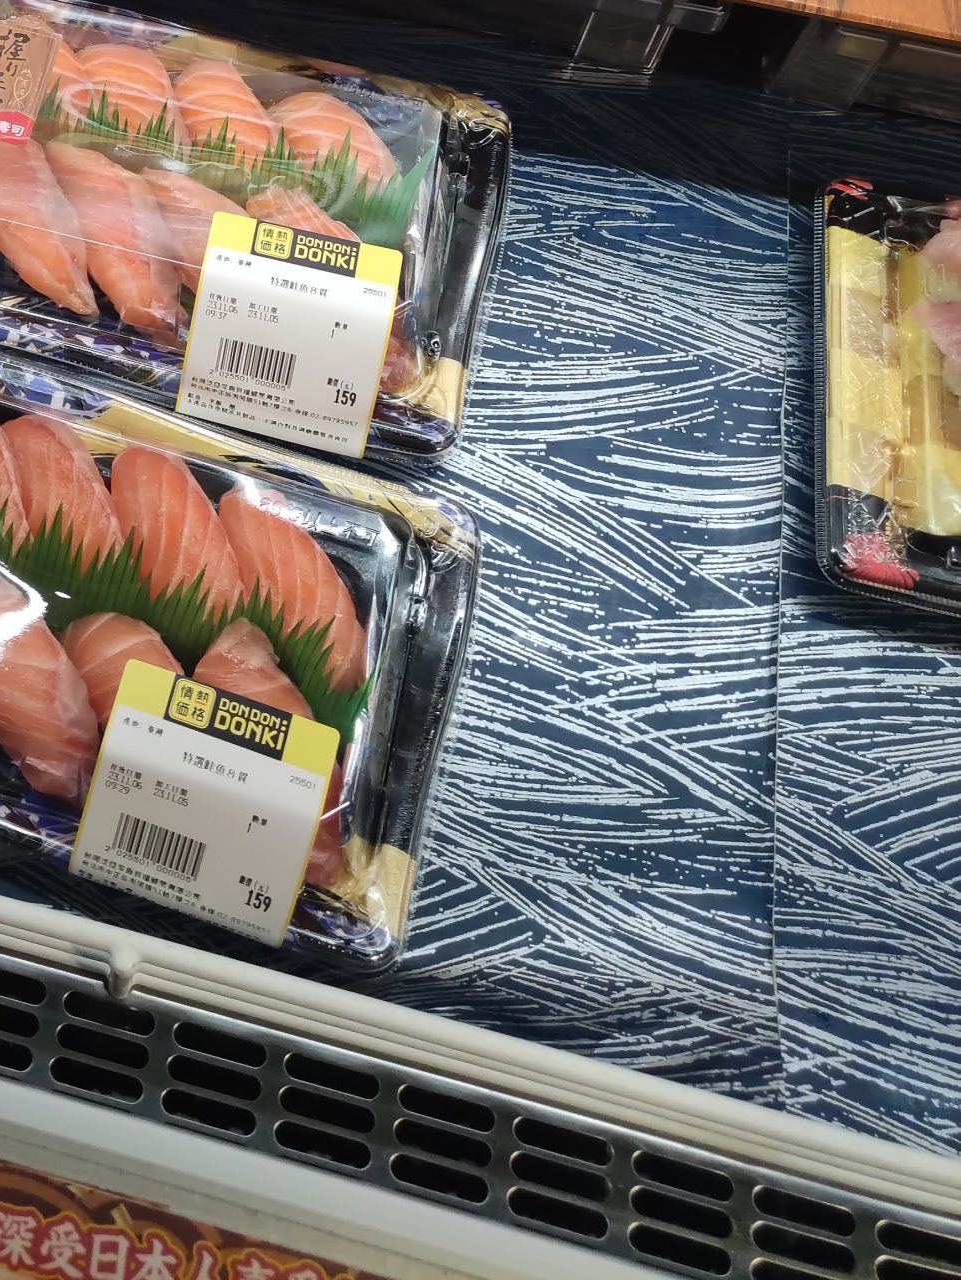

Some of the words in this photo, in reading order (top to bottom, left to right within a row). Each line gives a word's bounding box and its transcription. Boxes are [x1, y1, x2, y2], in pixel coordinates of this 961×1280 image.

[207, 300, 239, 315] 23.11.06
[247, 309, 279, 324] 23.11.05
[254, 379, 287, 392] 000005
[333, 388, 357, 407] 159
[180, 685, 210, 702] 情熱
[175, 701, 207, 722] 価格
[108, 771, 143, 791] 23.11.06
[152, 788, 189, 807] 23.11.05
[244, 889, 272, 913] 159
